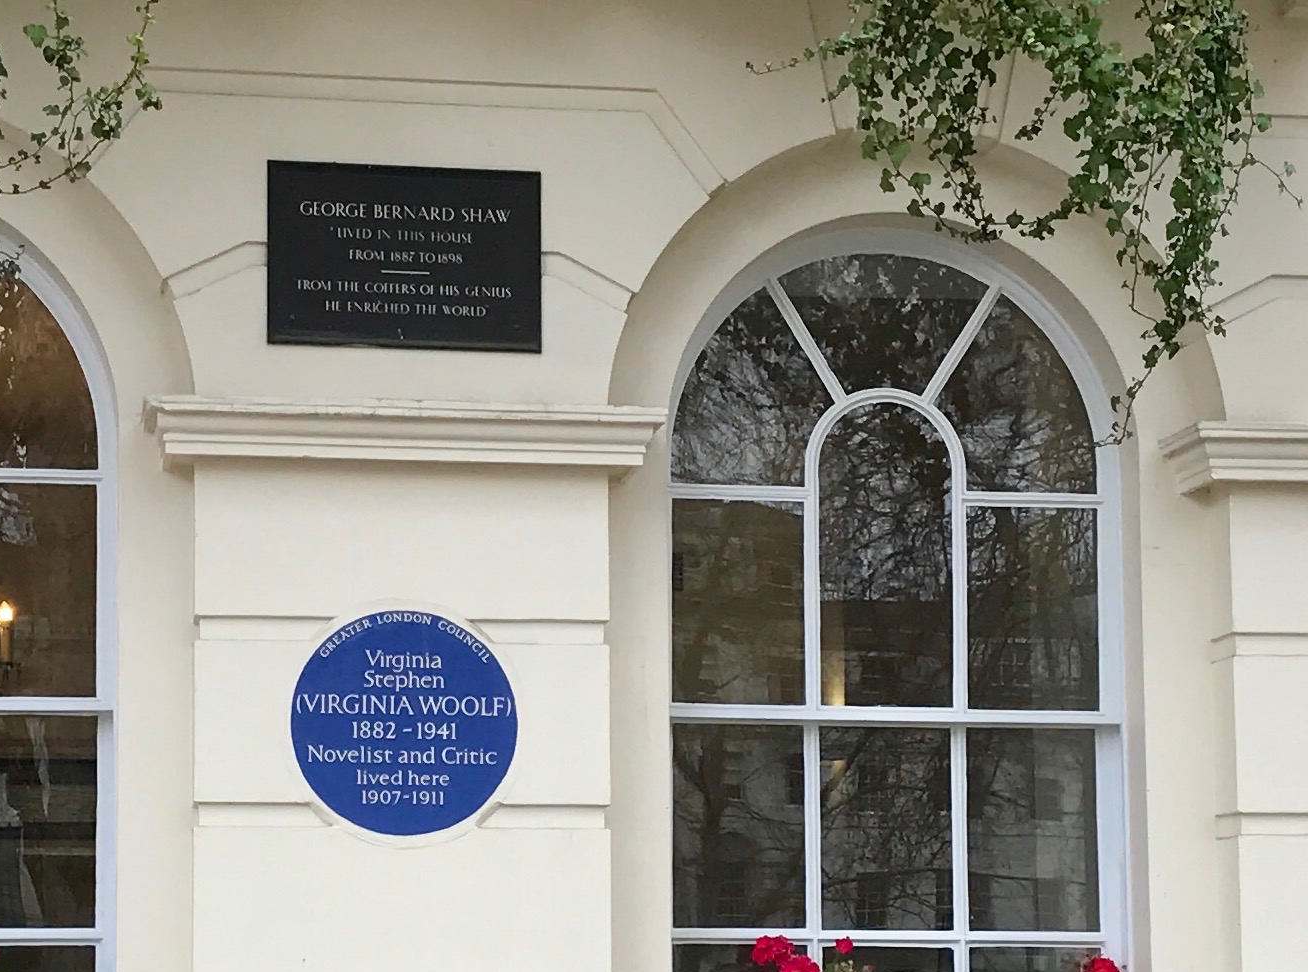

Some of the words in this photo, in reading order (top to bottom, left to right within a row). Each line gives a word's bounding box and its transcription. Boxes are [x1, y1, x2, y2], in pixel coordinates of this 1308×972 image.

[299, 200, 367, 218] GEORGE
[373, 204, 455, 222] BERNARD
[461, 208, 511, 223] SHAW
[377, 229, 391, 240] IN
[397, 230, 425, 241] THIS
[430, 231, 472, 244] HOUSE
[349, 249, 385, 261] FROM
[390, 251, 416, 263] 1887
[418, 252, 436, 263] TO
[437, 253, 463, 264] 1898
[336, 281, 360, 293] THE
[364, 282, 416, 295] COFFERS
[419, 284, 434, 295] OF
[439, 285, 460, 296] HIS
[465, 286, 512, 298] GENIUS
[325, 300, 342, 312] HE
[347, 300, 410, 314] ENRICHED
[414, 303, 437, 315] THE
[319, 618, 373, 658] GREATER
[376, 612, 433, 626] LONDON
[437, 620, 493, 664] COUNCIL
[364, 649, 443, 673] Virginia
[363, 670, 445, 692] Stephen
[295, 693, 415, 716] (VIRGINIA
[418, 695, 513, 718] WOOLF)
[307, 745, 393, 764] Novelist
[397, 746, 436, 764] and
[442, 746, 498, 766] Critic
[356, 769, 403, 786] lived
[407, 769, 450, 787] here
[361, 790, 445, 806] 1907-1911
